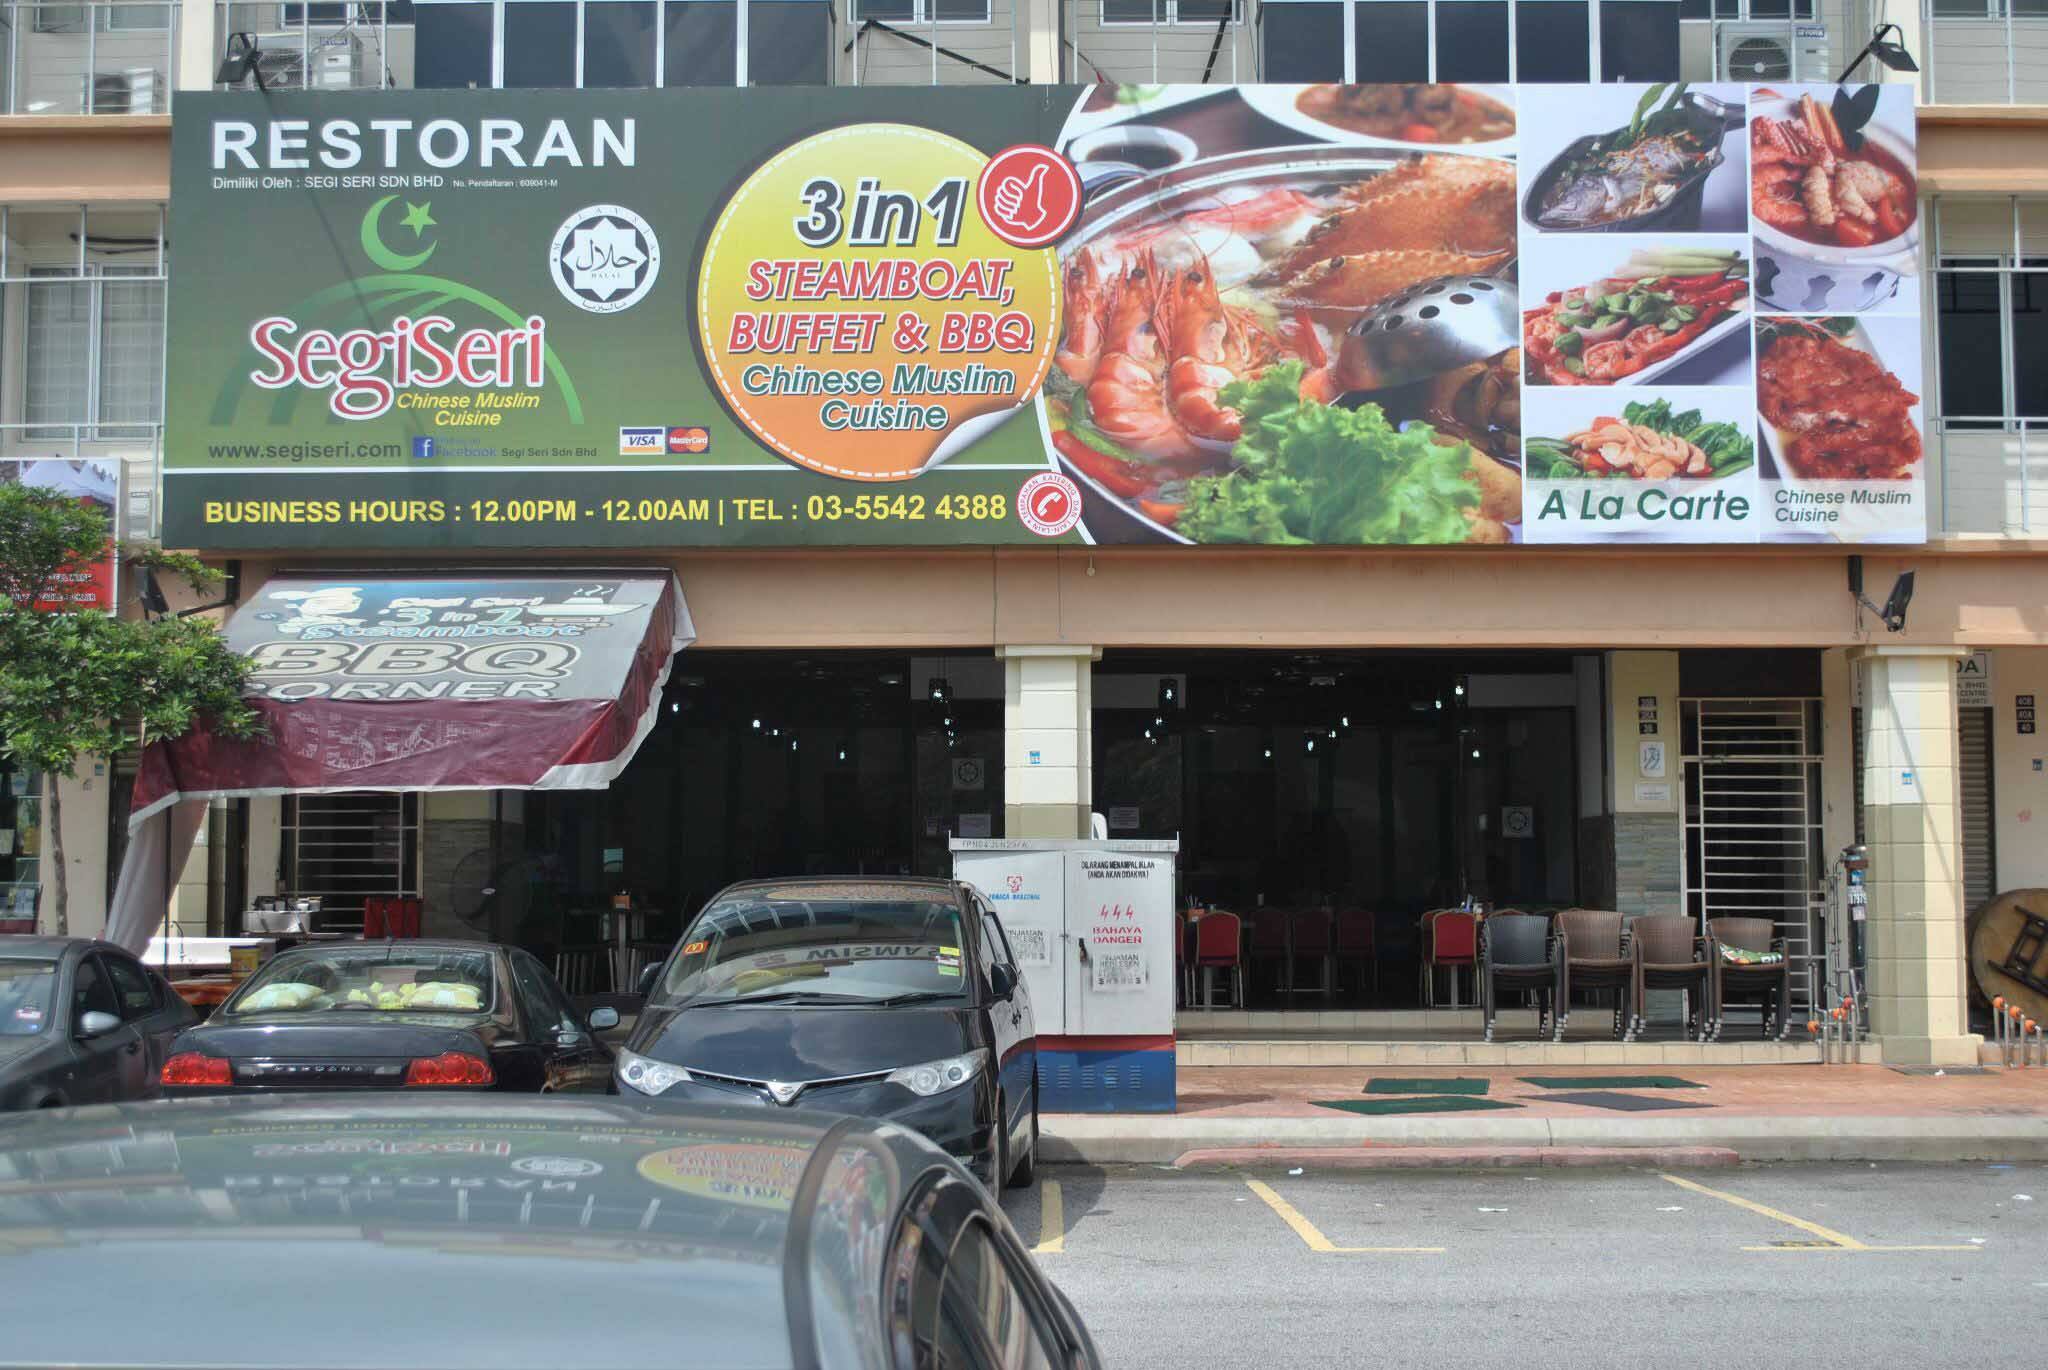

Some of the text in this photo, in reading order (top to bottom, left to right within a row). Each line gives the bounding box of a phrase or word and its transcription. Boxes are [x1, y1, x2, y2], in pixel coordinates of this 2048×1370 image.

[212, 119, 637, 169] RESTORAN
[213, 176, 258, 189] Dimiliki
[262, 176, 292, 189] Oleh
[304, 176, 338, 188] SEGI
[342, 176, 375, 188] SERI
[379, 176, 409, 188] SDN
[413, 175, 444, 187] BHD
[744, 257, 1014, 306] STEAMBOAT,
[727, 312, 1035, 354] BUFFET & BBQ
[250, 314, 546, 421] SegiSeri
[742, 362, 1016, 396] Chinese Muslim
[397, 391, 540, 410] Chinese Muslim
[434, 410, 502, 427] Cuisine
[820, 399, 950, 431] Cuisine
[629, 435, 656, 446] VISA
[208, 441, 402, 463] www.segiseri.com
[502, 448, 525, 459] Segi
[528, 448, 549, 457] Seri
[552, 447, 573, 457] Sdn
[575, 447, 598, 457] Bhd
[1538, 488, 1750, 521] A La Carte
[1774, 489, 1912, 505] Chinese Muslim
[205, 501, 342, 523] BUSINESS
[349, 500, 446, 522] HOURS
[470, 499, 577, 522] 12.00PM
[602, 499, 710, 521] 12.00AM
[733, 499, 783, 520] TEL
[807, 494, 925, 520] 03-5542
[935, 494, 1007, 520] 4388
[1774, 506, 1839, 523] Cuisine
[300, 622, 583, 641] Steamboat
[246, 640, 581, 679] BBQ
[1092, 926, 1143, 934] BAHAYA
[1093, 935, 1143, 944] DANGER
